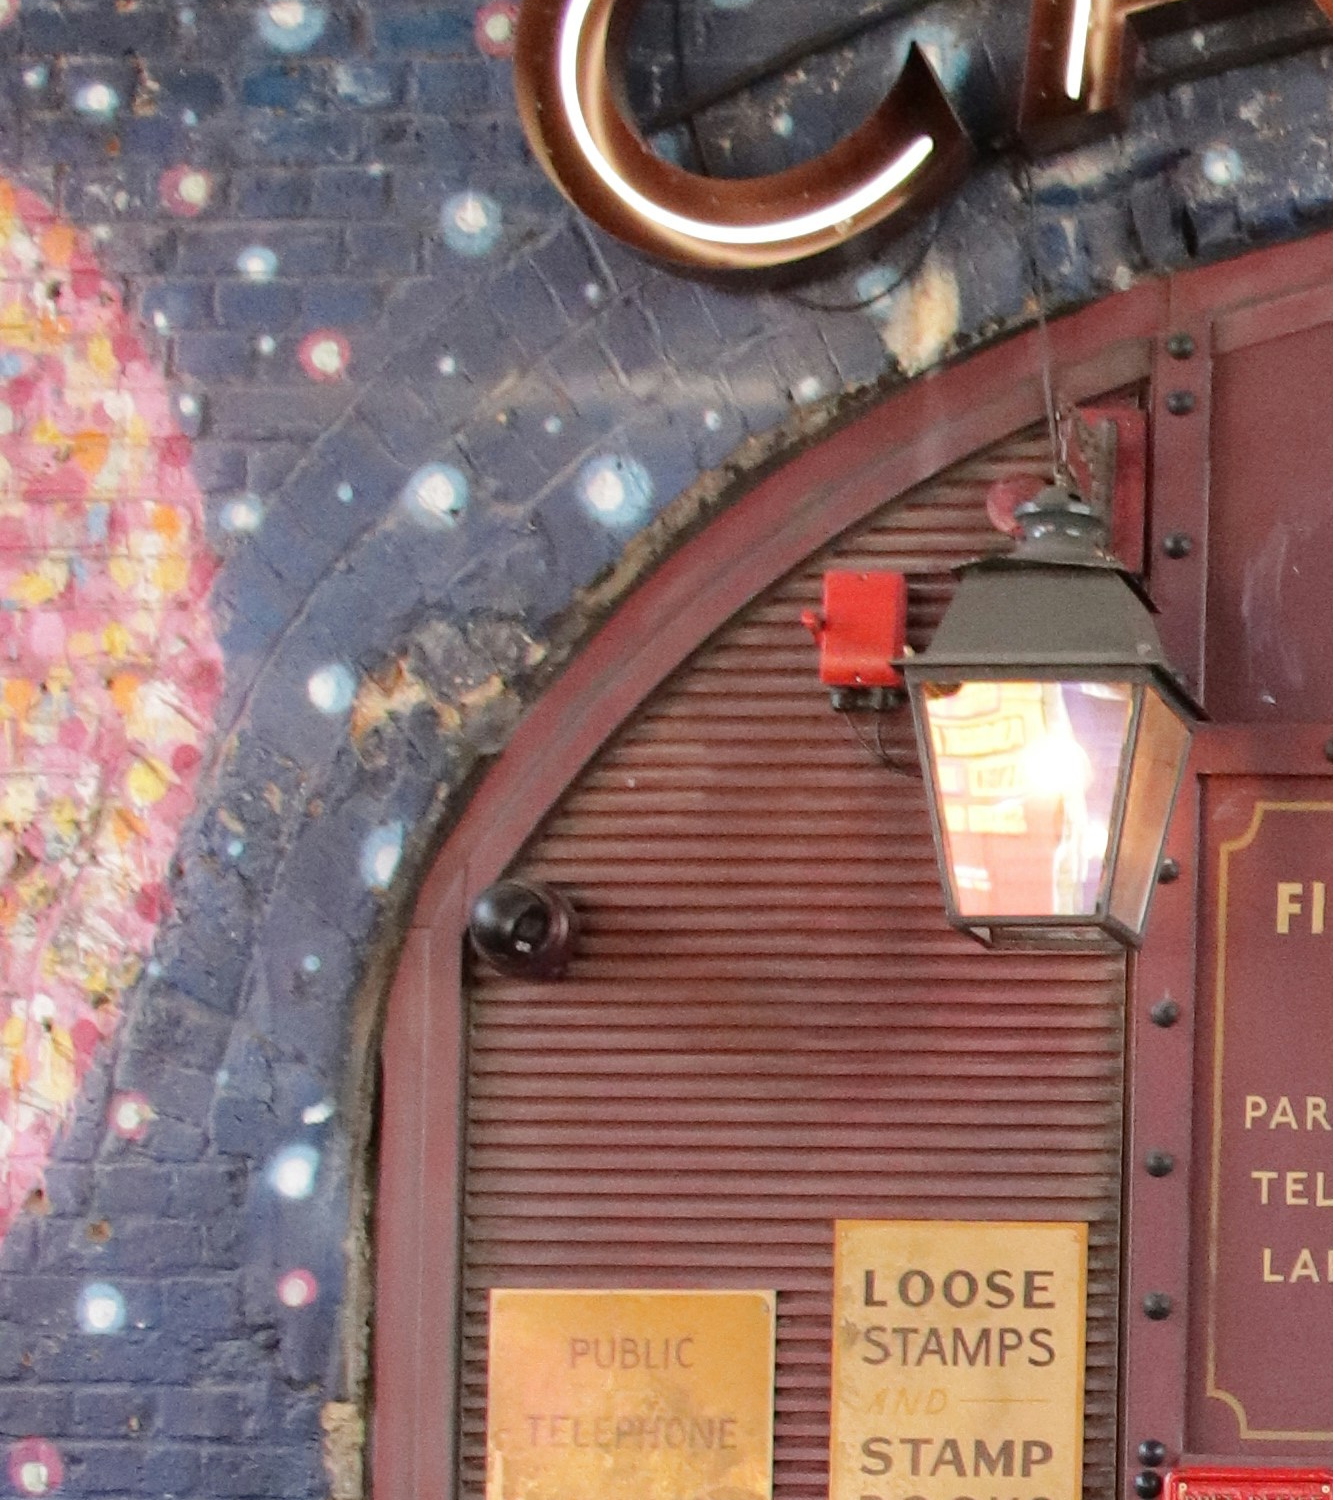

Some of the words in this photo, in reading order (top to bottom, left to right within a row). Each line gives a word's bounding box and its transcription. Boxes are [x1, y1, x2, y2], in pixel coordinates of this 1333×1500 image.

[863, 1269, 1055, 1309] LOOSE
[569, 1335, 694, 1370] PUBLIC
[861, 1327, 1055, 1367] STAMPS
[860, 1438, 1053, 1477] STAMP
